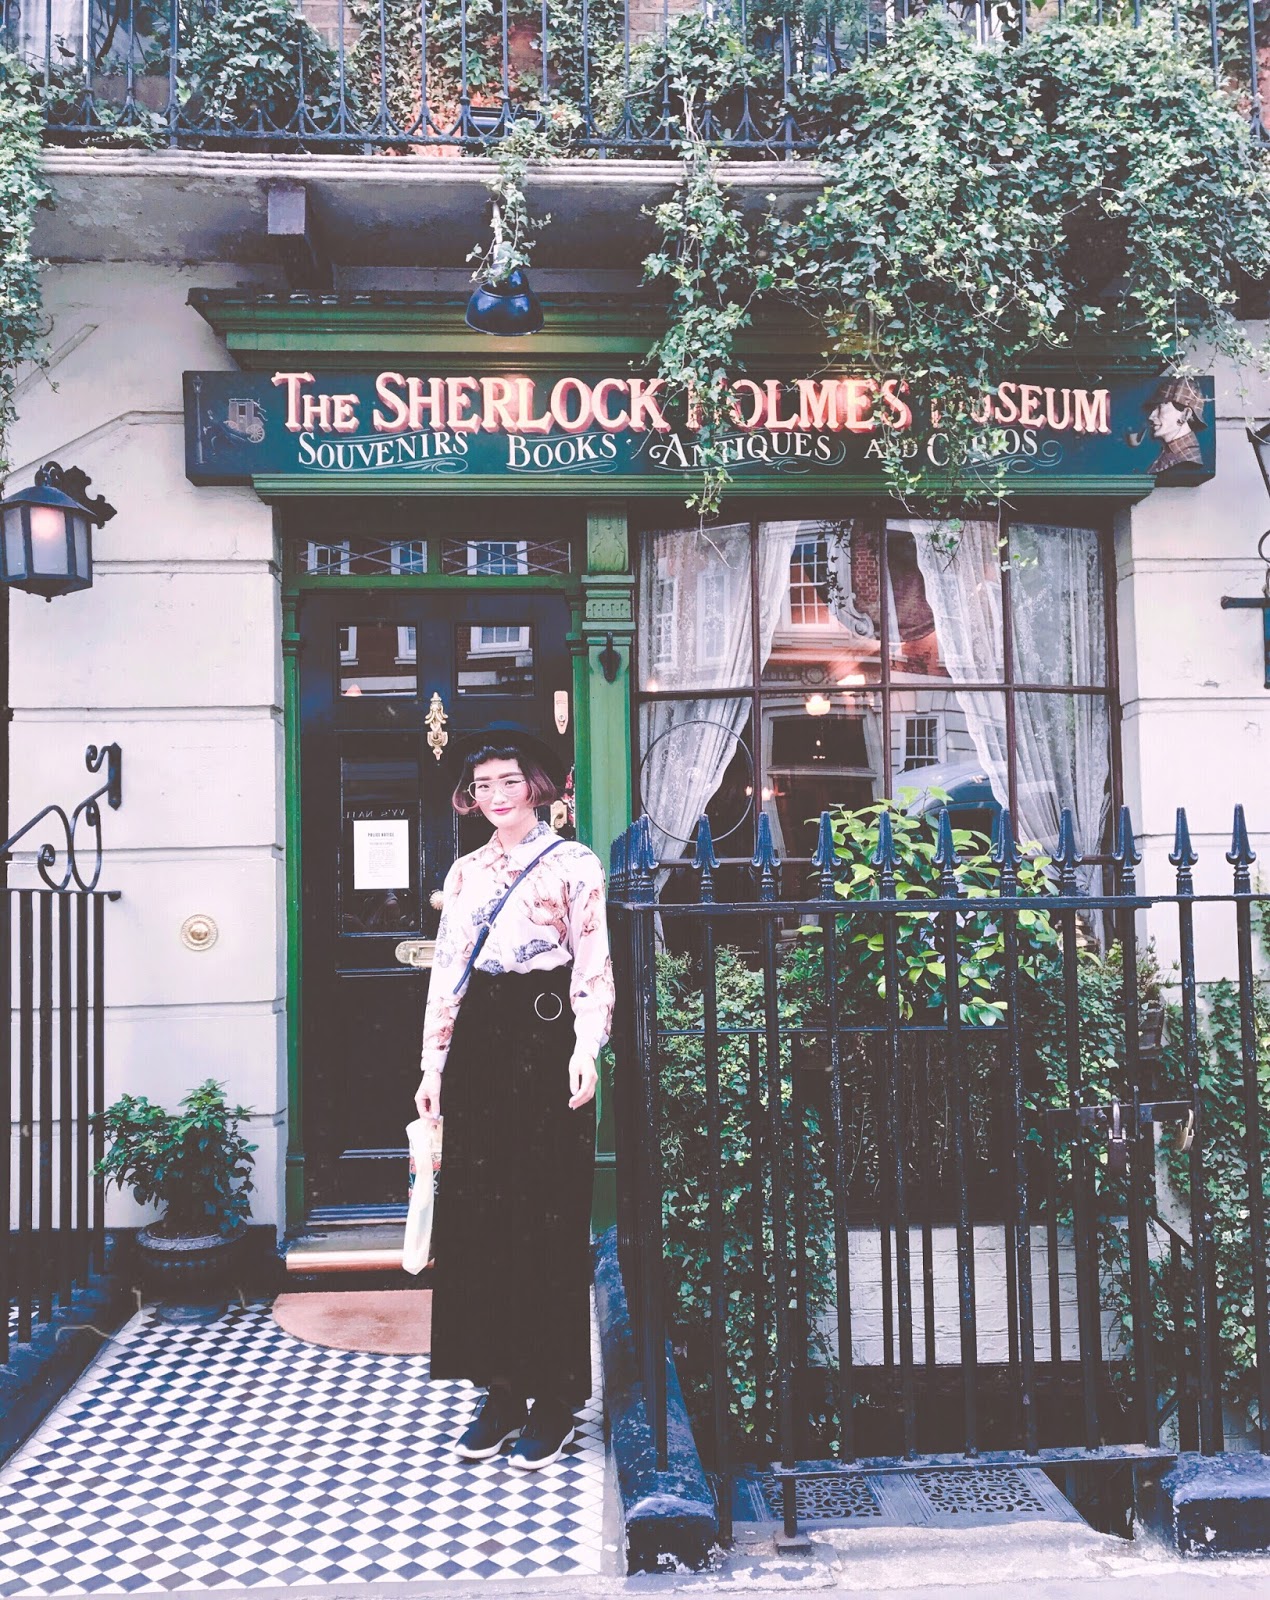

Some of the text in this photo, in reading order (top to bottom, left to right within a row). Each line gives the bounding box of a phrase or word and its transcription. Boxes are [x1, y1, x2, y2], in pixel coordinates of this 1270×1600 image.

[271, 371, 361, 433] THE
[373, 371, 672, 435] SHERLOCK
[930, 381, 1112, 435] USEUM
[298, 430, 469, 470] SOUVENIRS
[506, 433, 617, 468] BOOKS
[926, 428, 1038, 467] CRIOS
